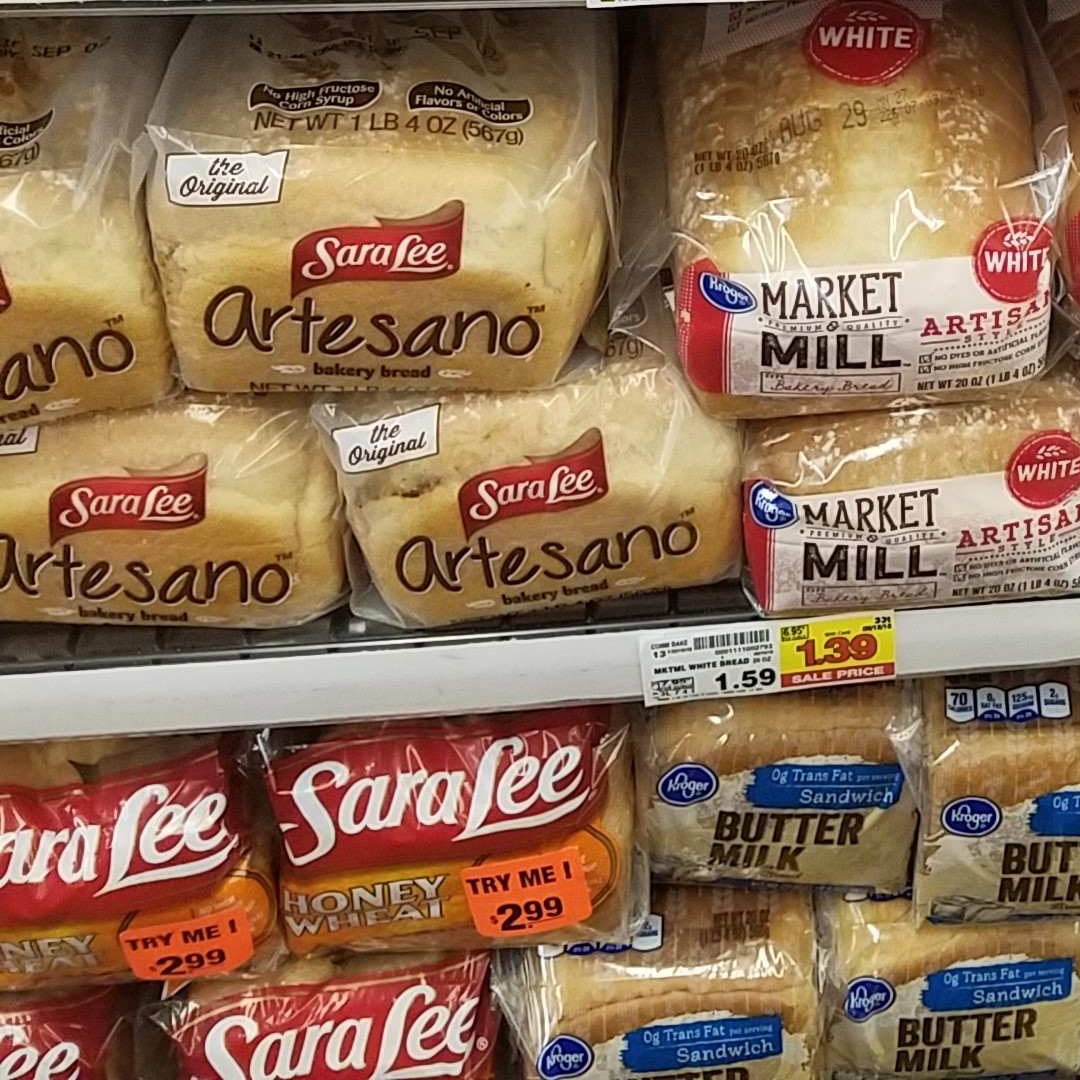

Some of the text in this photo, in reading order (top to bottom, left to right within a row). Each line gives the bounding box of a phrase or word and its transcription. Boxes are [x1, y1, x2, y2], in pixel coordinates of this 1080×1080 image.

[818, 26, 914, 48] WHITE
[841, 100, 869, 129] 29
[208, 157, 245, 176] the
[179, 175, 269, 201] Original
[761, 331, 901, 368] MILL
[369, 422, 401, 442] the
[802, 488, 939, 532] MARKET
[803, 542, 938, 581] MILL
[797, 634, 877, 667] 1.39
[689, 657, 750, 670] WHITE BREAD
[792, 667, 885, 684] SALE PRICE
[715, 668, 776, 690] 1.59
[792, 769, 853, 784] Trans Fat
[799, 788, 894, 804] Sandwich
[713, 811, 864, 846] BUTTER
[465, 867, 554, 895] TRY ME
[284, 875, 448, 916] HONEY
[125, 925, 221, 951] TRY ME
[962, 966, 1020, 983] Trans Fat
[973, 980, 1062, 1005] Sandwich
[662, 1024, 725, 1042] Trans Fat
[899, 1009, 1037, 1048] BUTTER
[677, 1038, 774, 1063] Sandwich
[894, 1045, 987, 1074] MILK
